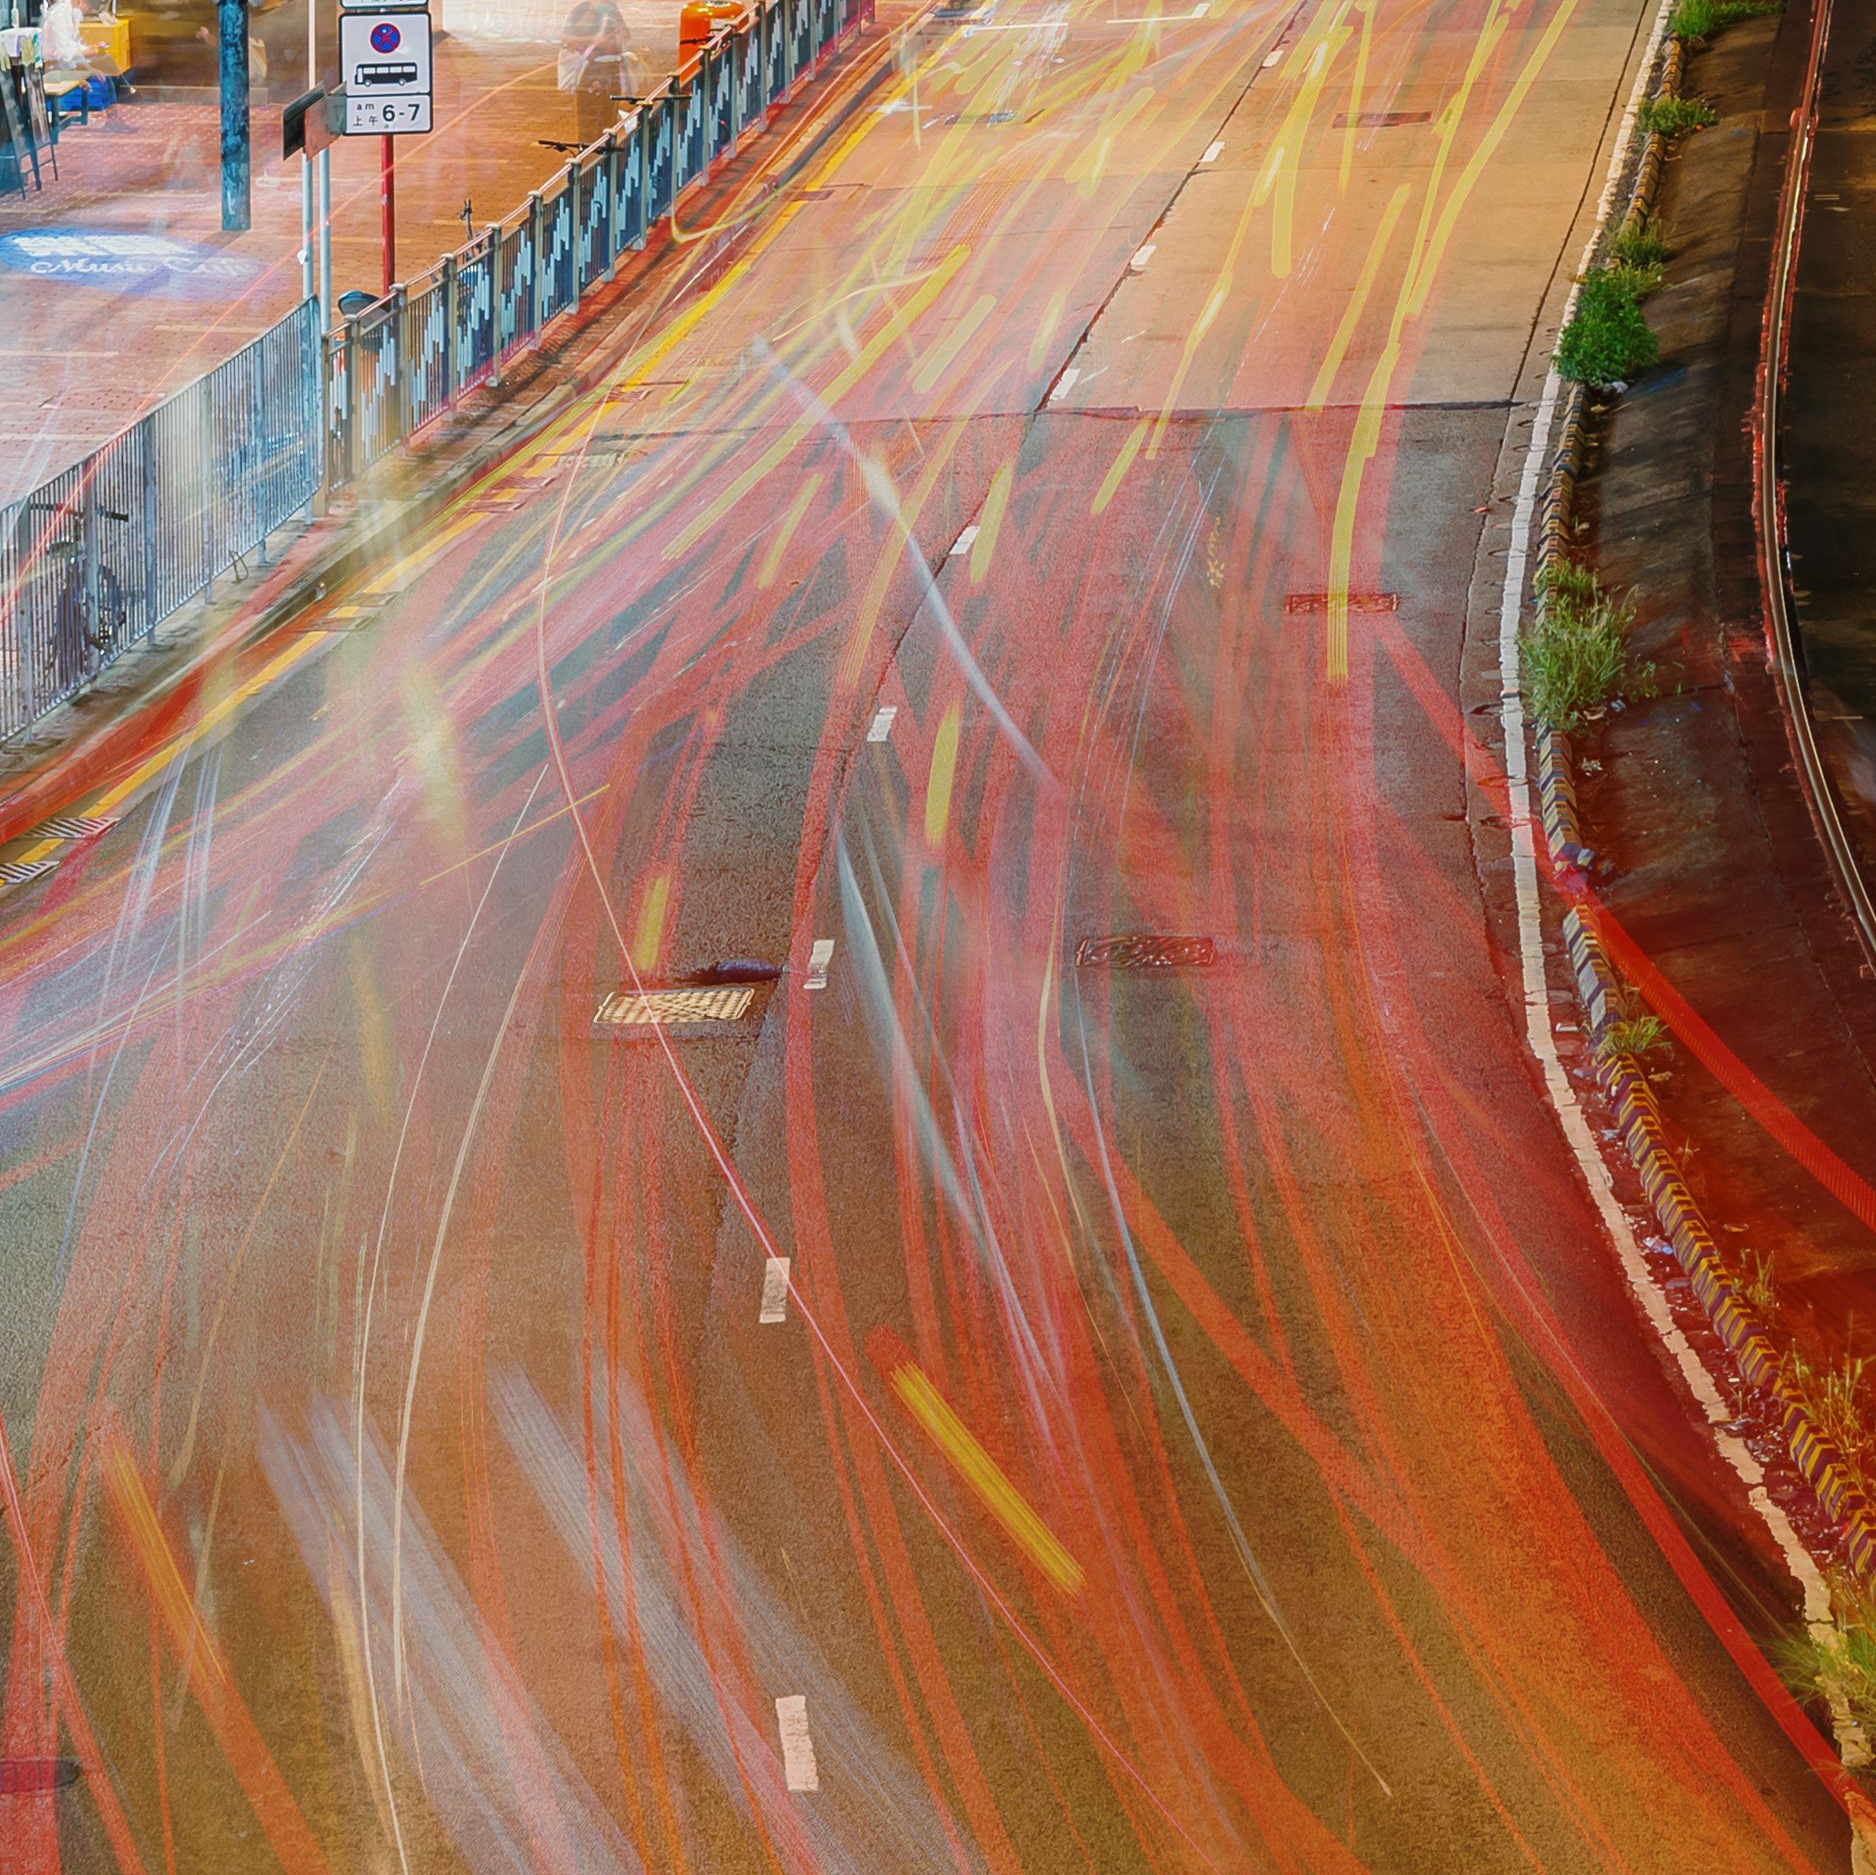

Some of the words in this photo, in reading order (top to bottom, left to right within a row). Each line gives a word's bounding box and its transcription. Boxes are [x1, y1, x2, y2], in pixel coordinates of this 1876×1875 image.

[356, 102, 375, 110] am
[382, 103, 420, 122] 6-7
[353, 115, 378, 126] 上午
